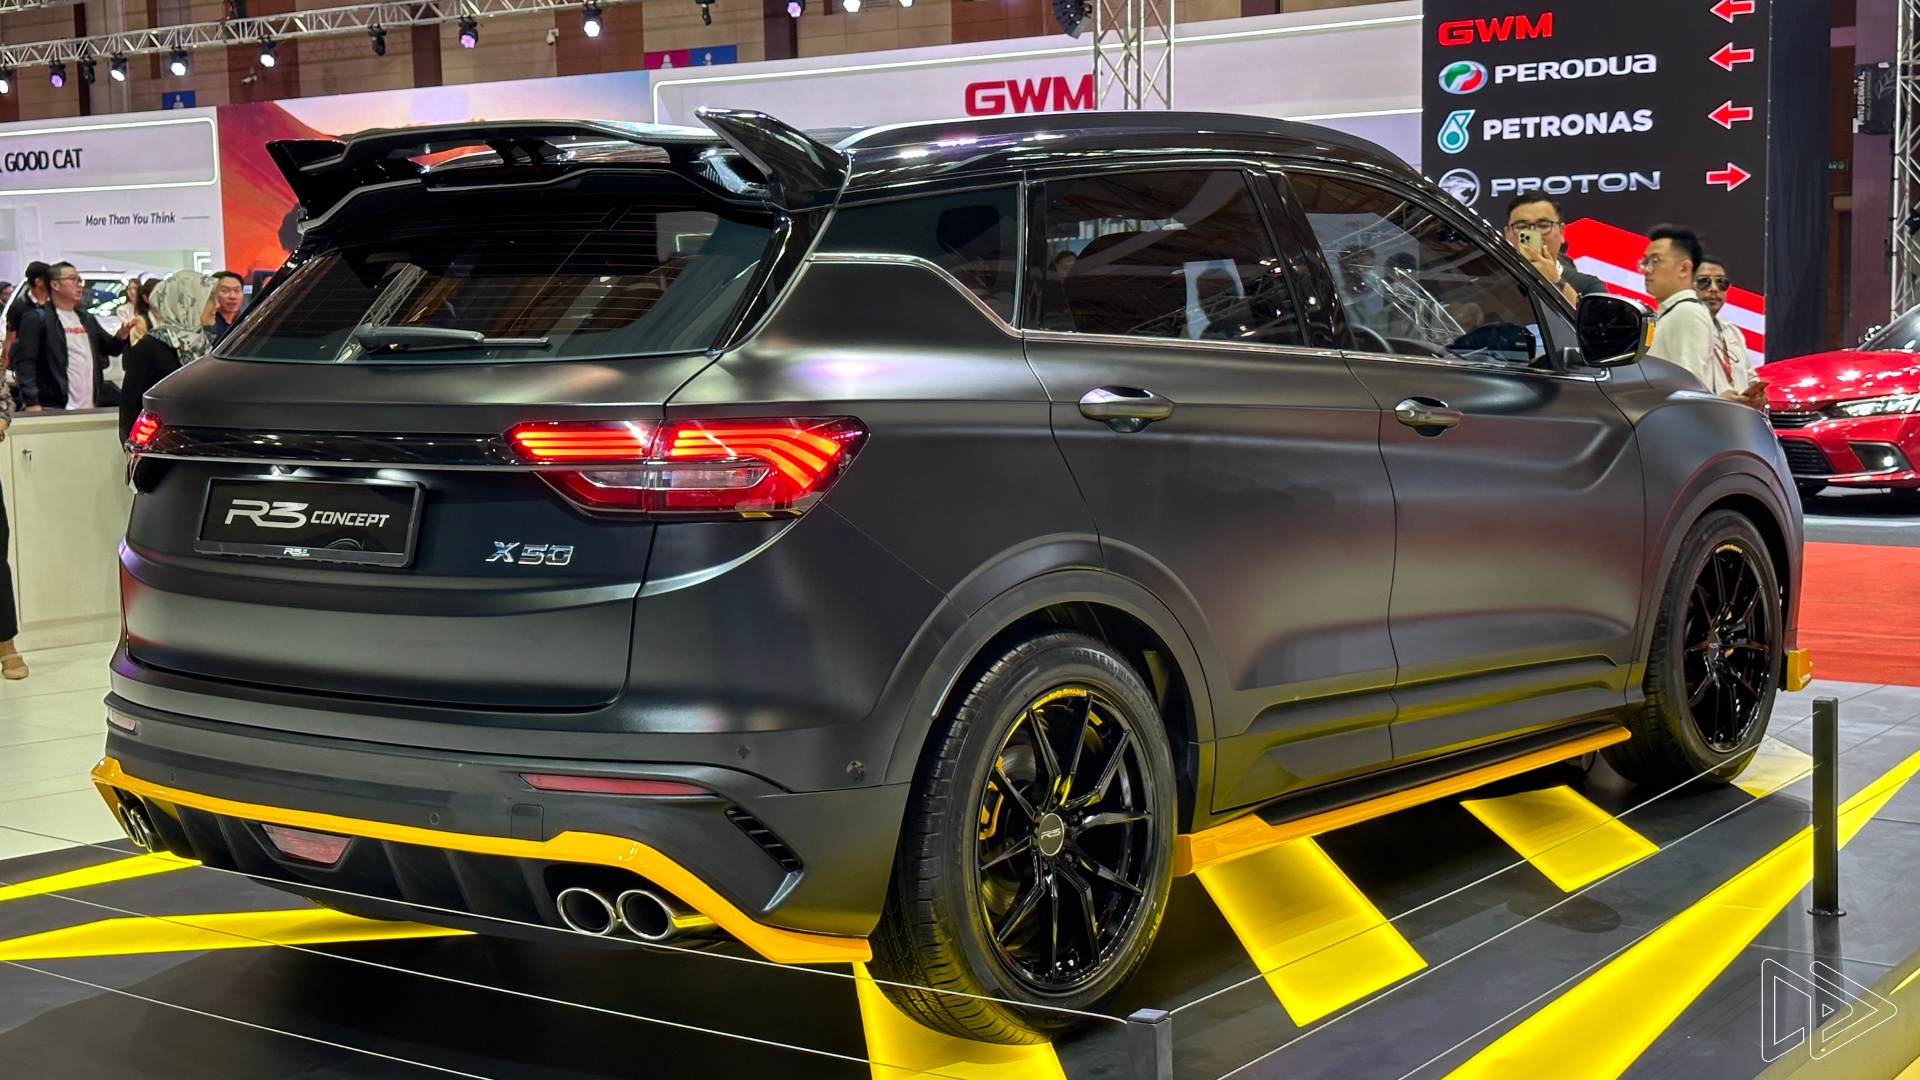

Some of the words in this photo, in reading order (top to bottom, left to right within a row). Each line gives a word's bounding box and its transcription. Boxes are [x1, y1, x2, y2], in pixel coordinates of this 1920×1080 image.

[1437, 12, 1553, 46] GWM
[965, 74, 1094, 116] GWM
[1483, 109, 1653, 141] PETRONAS
[5, 151, 49, 172] GOOD
[53, 148, 83, 169] CAT
[1490, 171, 1661, 197] PROTON
[85, 215, 107, 226] More
[109, 213, 130, 225] Than
[133, 213, 148, 225] You
[151, 212, 176, 224] Think
[225, 499, 309, 529] R3
[310, 510, 390, 528] CONCEPT
[485, 541, 574, 566] X50
